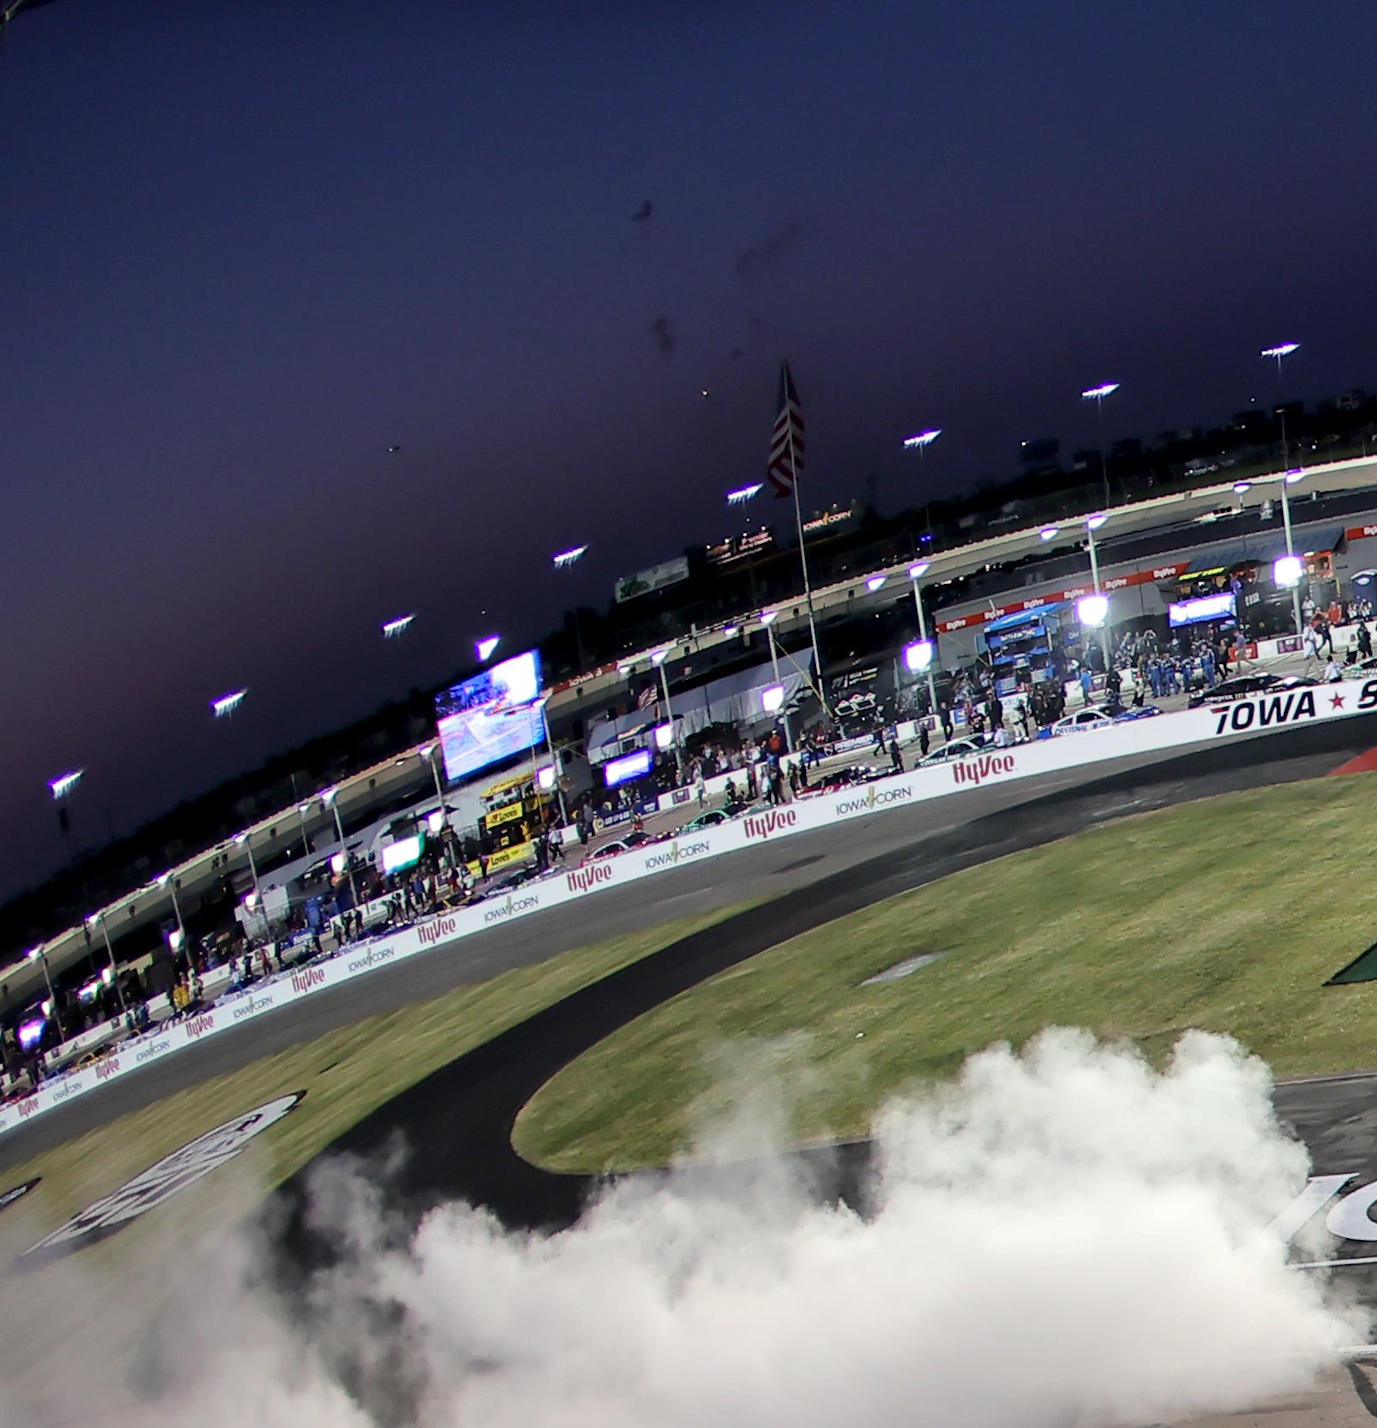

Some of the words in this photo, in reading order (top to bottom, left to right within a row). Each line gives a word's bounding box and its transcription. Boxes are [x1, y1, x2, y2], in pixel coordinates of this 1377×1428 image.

[1211, 689, 1317, 735] IOWA
[953, 755, 1015, 785] HyVee
[835, 798, 868, 816] IOWA
[877, 786, 912, 805] CORN
[743, 807, 797, 840] HyVee
[645, 852, 672, 869] IOWA
[679, 841, 710, 860] CORN
[567, 863, 611, 892] HyVee
[484, 906, 508, 922] IOWA
[512, 895, 539, 914] CORN
[417, 917, 456, 944] HyVee
[292, 968, 325, 993] HyVee
